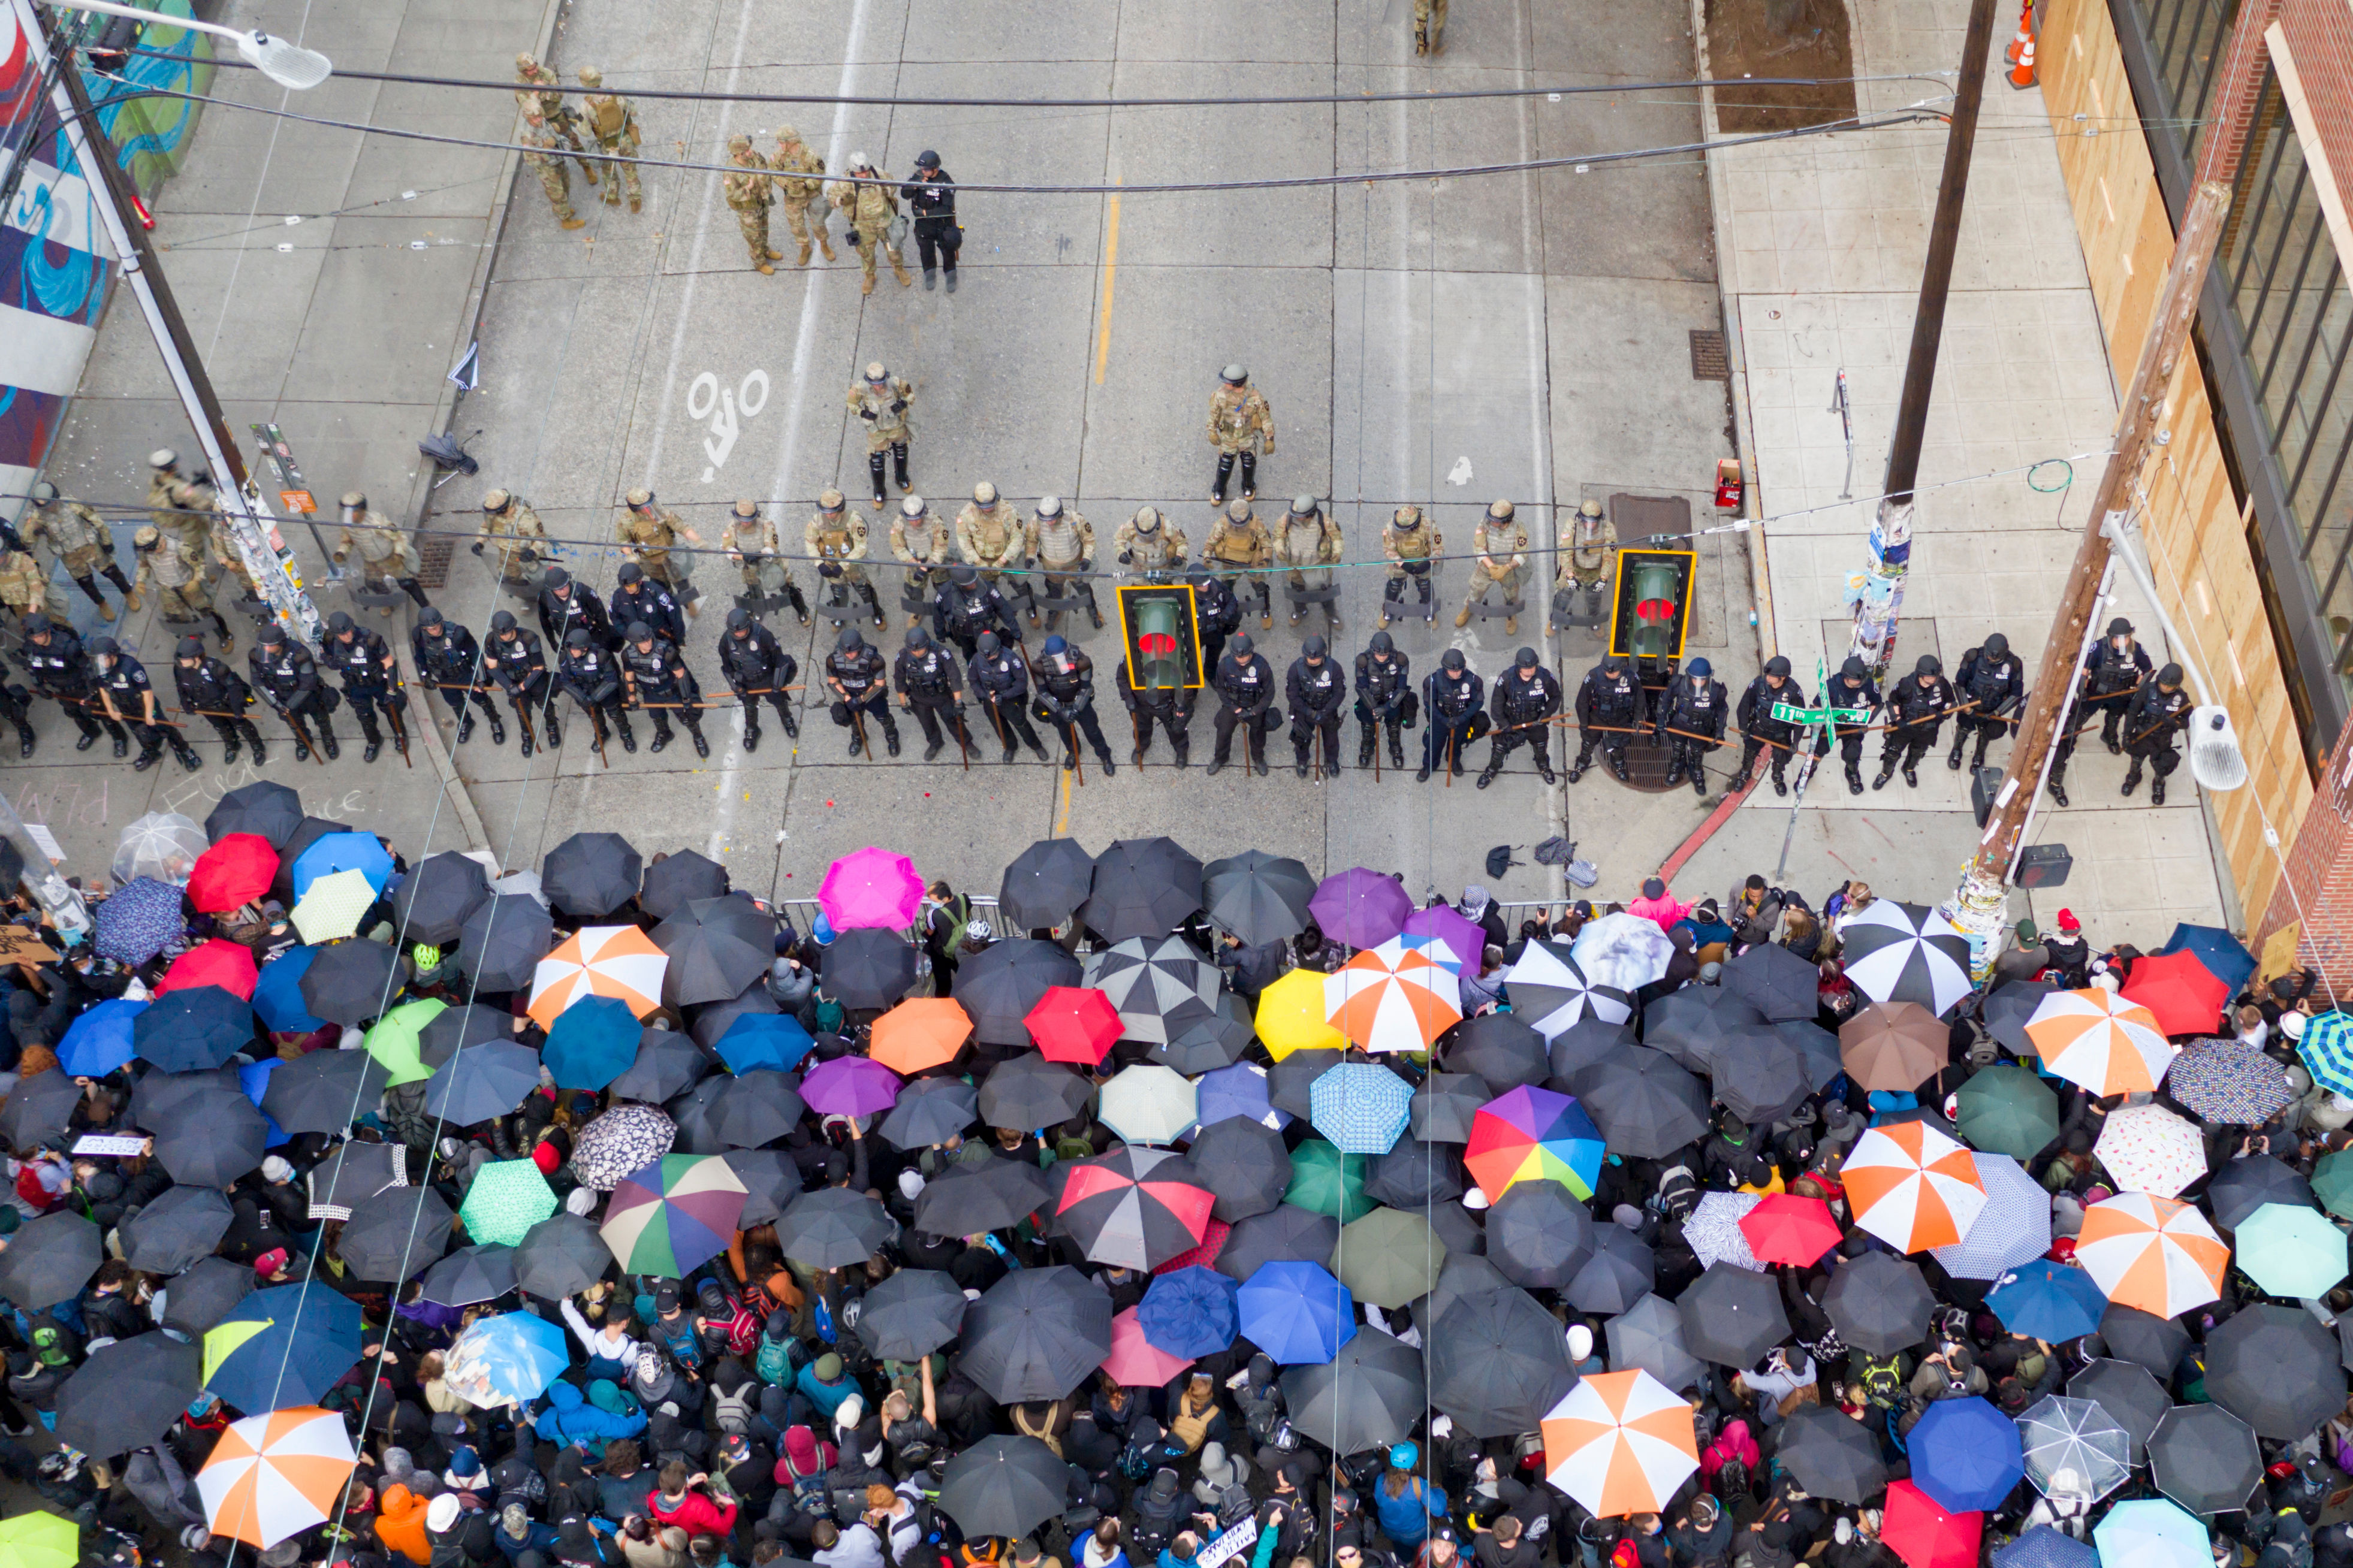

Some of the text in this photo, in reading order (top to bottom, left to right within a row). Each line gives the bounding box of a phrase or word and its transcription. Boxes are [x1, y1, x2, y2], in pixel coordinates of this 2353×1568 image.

[511, 651, 527, 659] POLICE
[1529, 688, 1544, 697] POLICE
[1779, 706, 1805, 721] 11th
